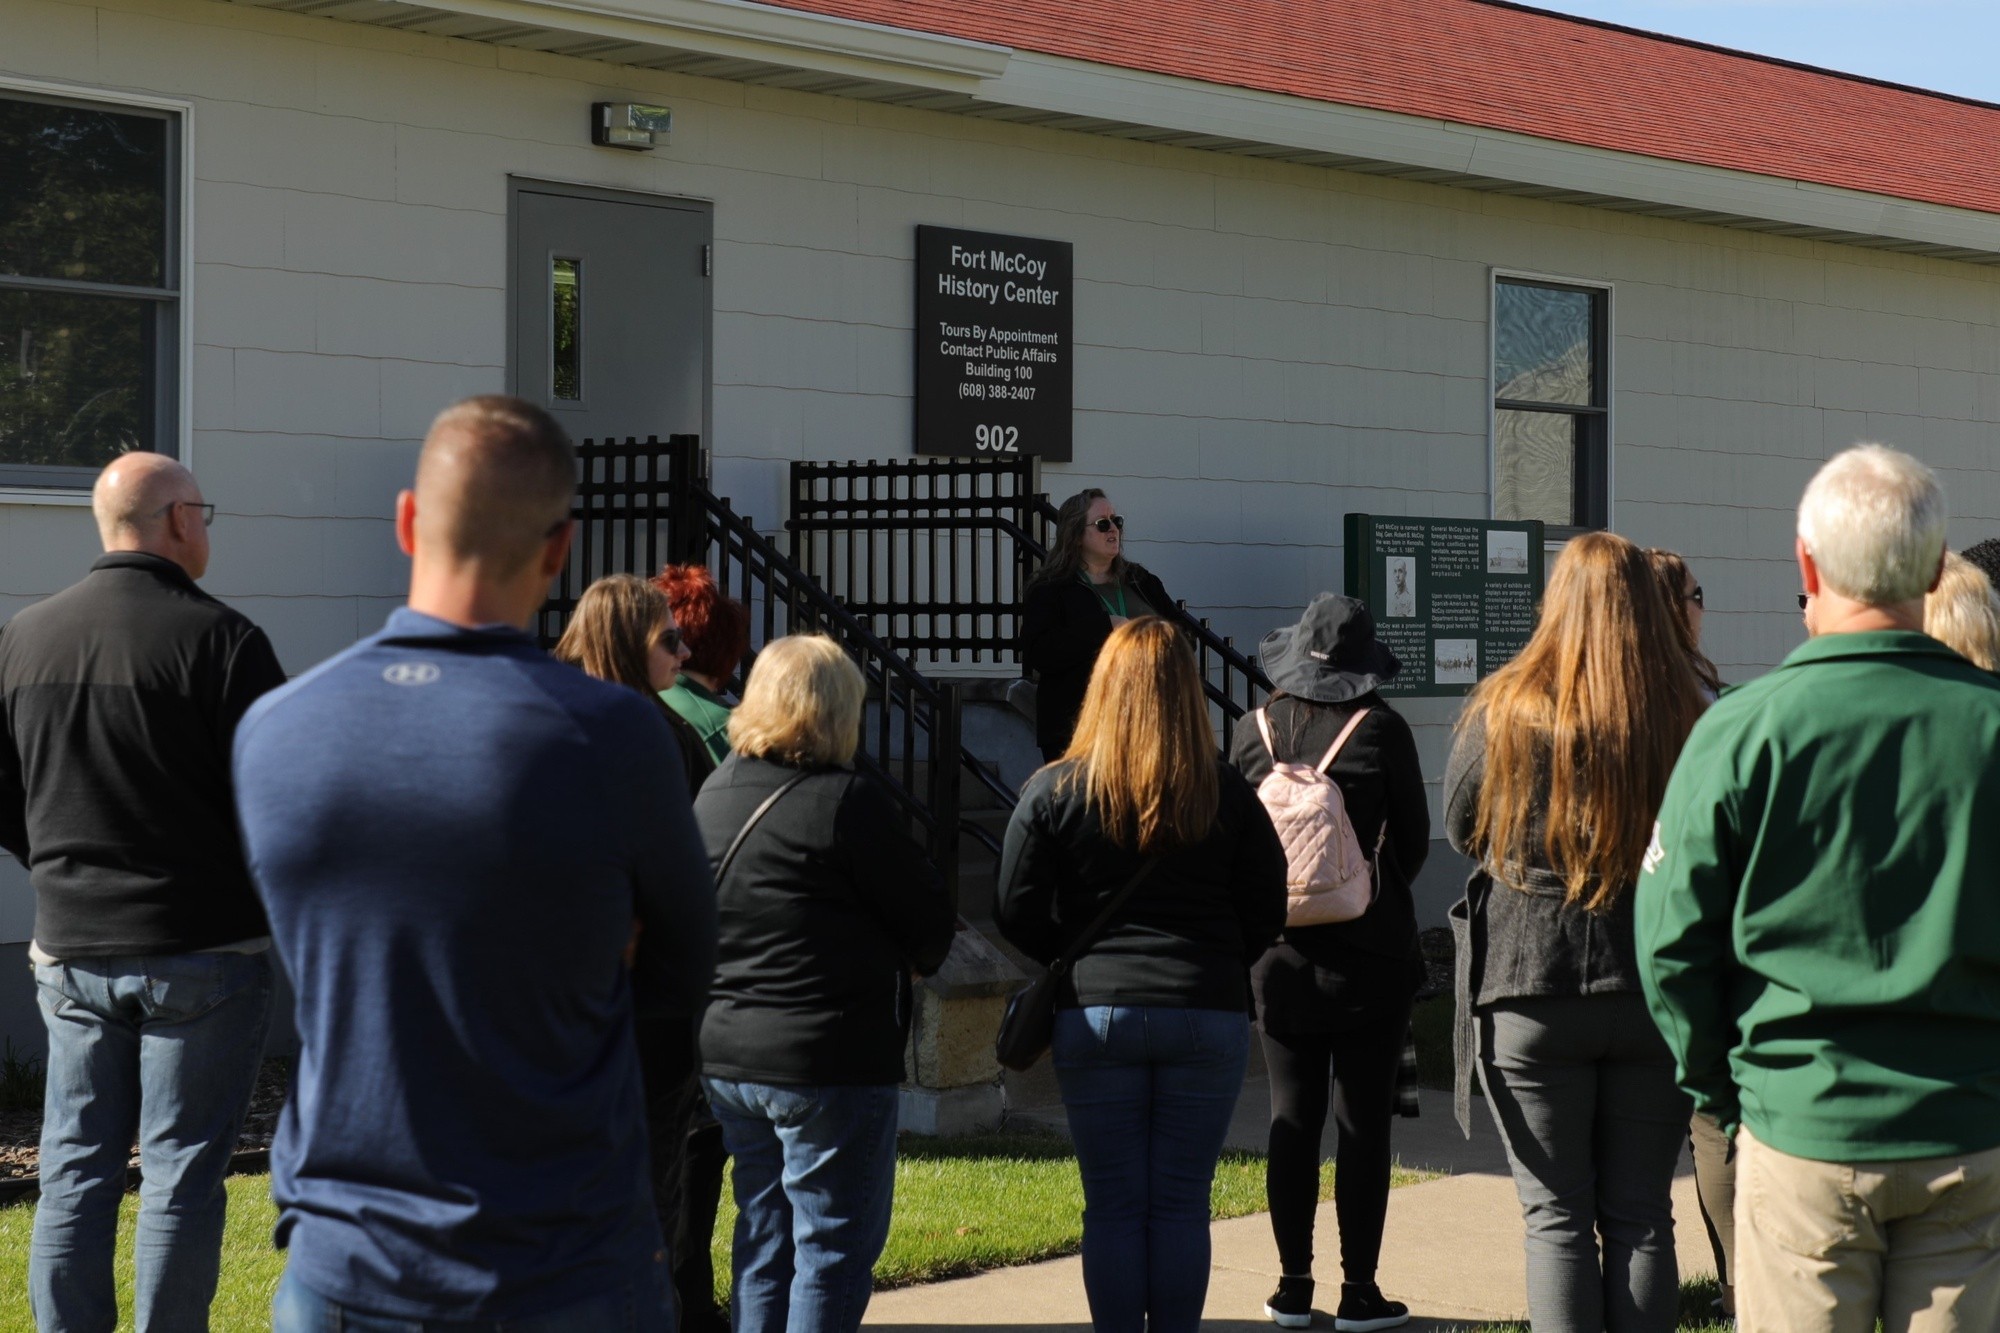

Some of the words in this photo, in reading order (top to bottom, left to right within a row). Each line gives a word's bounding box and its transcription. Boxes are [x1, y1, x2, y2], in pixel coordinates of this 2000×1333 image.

[952, 245, 986, 270] Fort
[990, 250, 1046, 280] McCoy
[938, 274, 999, 305] History
[1004, 281, 1059, 306] Center
[940, 322, 970, 338] Tours
[973, 325, 987, 342] By
[989, 326, 1058, 344] Appointment
[940, 341, 983, 358] Contact
[986, 344, 1020, 361] Public
[1022, 348, 1057, 363] Affairs
[966, 362, 1010, 382] Building
[1014, 366, 1032, 380] 100
[959, 382, 986, 400] (608)
[988, 385, 1036, 400] 388-2407
[976, 424, 1019, 452] 902
